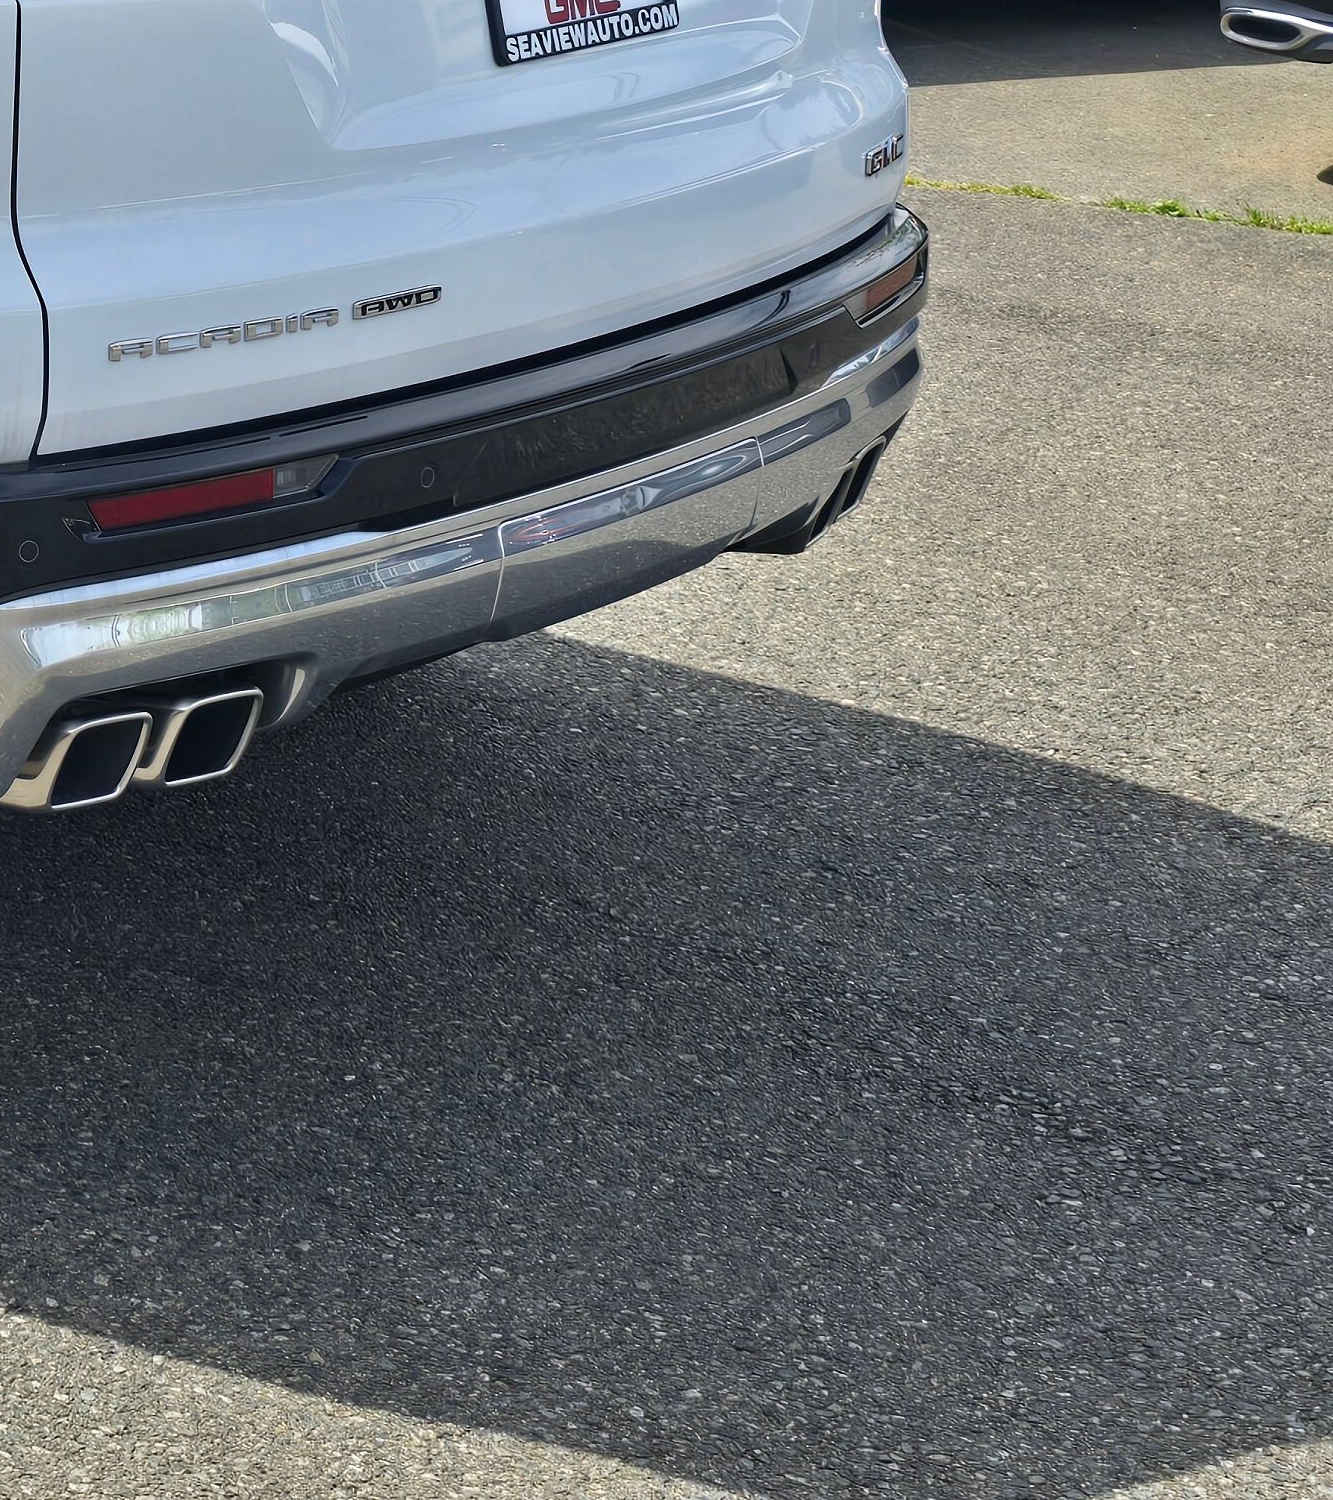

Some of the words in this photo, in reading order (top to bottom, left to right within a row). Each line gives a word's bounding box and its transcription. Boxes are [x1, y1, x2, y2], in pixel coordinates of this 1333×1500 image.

[506, 4, 678, 62] SEAVIEWAUTO.COM
[863, 133, 904, 177] GMC
[108, 307, 339, 362] ACADIA
[354, 286, 442, 320] AWD
